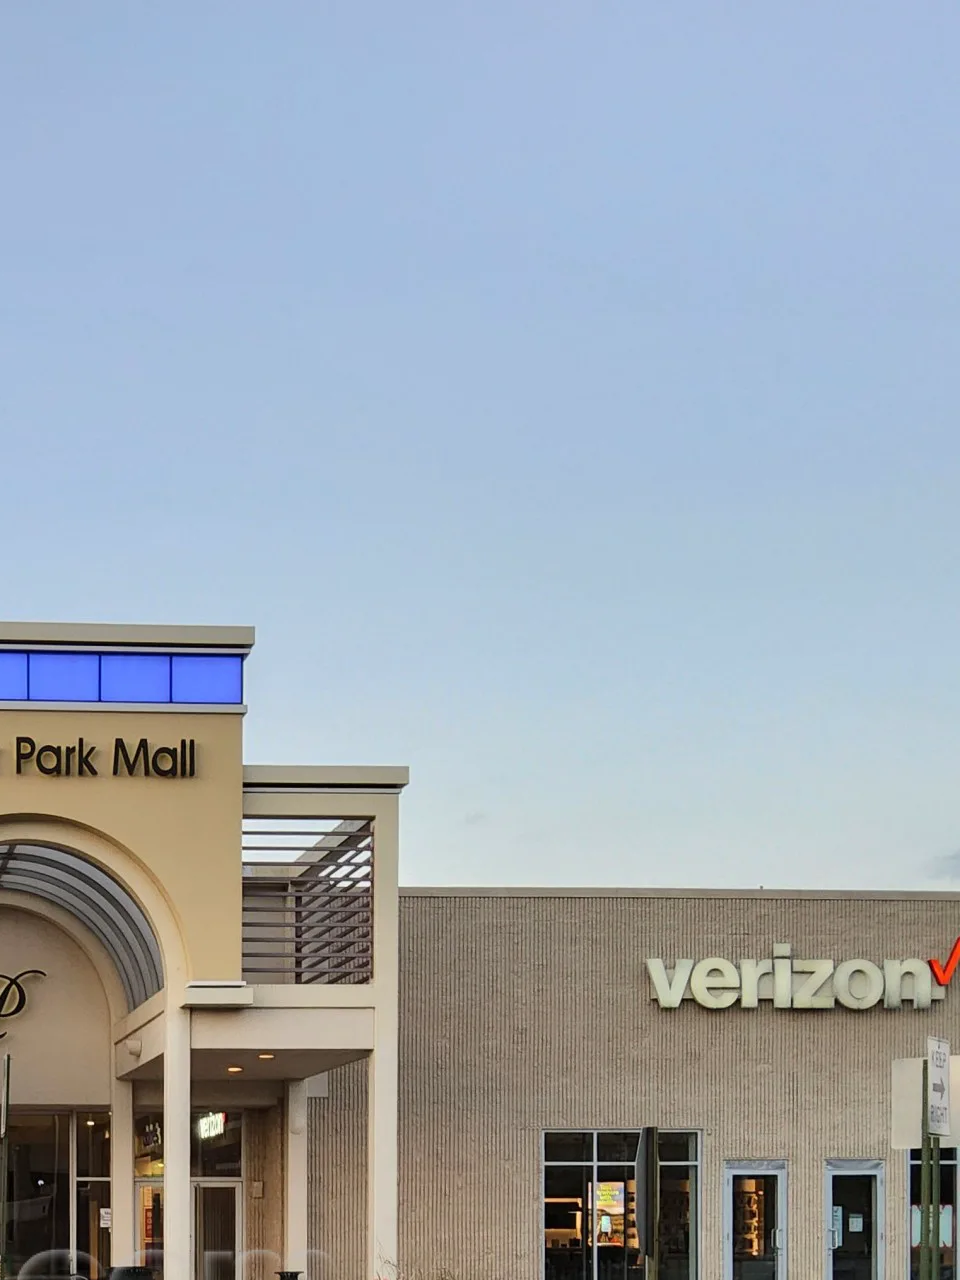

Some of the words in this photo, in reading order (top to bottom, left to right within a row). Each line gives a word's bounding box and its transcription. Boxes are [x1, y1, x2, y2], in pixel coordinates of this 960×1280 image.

[15, 736, 97, 776] Park
[112, 737, 195, 777] Mall
[646, 943, 932, 1010] verizon
[931, 1050, 946, 1069] KEEP
[199, 1111, 224, 1139] verizon
[930, 1104, 948, 1125] RIGHT
